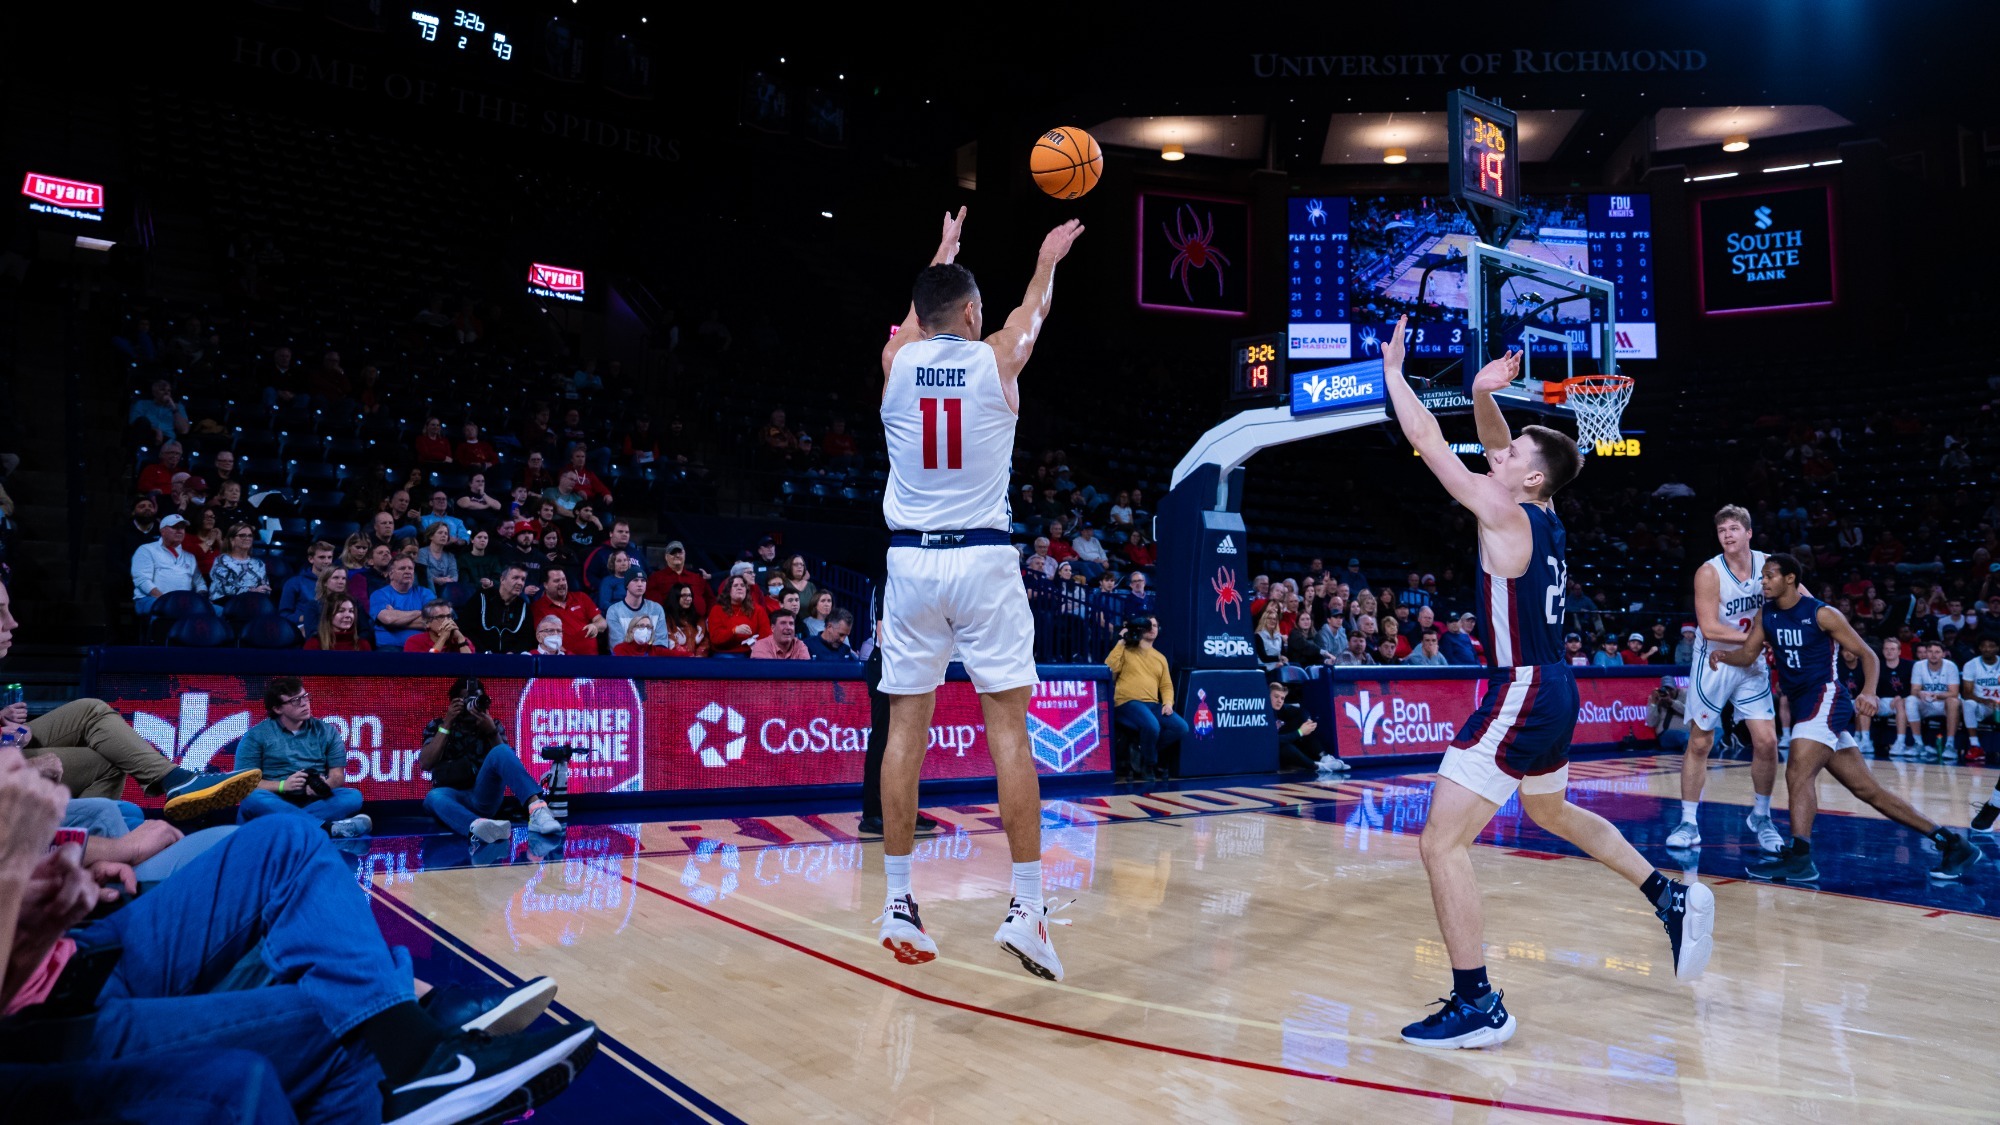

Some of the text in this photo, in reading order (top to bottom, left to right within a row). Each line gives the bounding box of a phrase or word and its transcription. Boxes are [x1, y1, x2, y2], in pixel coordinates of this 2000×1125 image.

[418, 21, 437, 41] 73
[454, 9, 485, 32] 3:26
[458, 36, 467, 49] 2
[492, 41, 512, 60] 43
[1460, 53, 1502, 75] OF
[231, 34, 682, 163] HOME OF THE SPIDERS
[1473, 116, 1506, 152] 3:26
[1480, 152, 1505, 197] 19
[35, 178, 94, 203] bryant
[1610, 196, 1631, 210] FDU
[1727, 230, 1803, 253] SOUTH
[1732, 249, 1800, 274] STATE
[537, 267, 577, 287] bryant
[1747, 269, 1786, 282] BANK
[1404, 328, 1425, 343] 73
[1450, 328, 1462, 343] 3
[916, 367, 966, 387] ROCHE
[1252, 365, 1268, 388] 19
[1332, 375, 1357, 388] Bon
[1324, 383, 1373, 401] Secours
[1423, 391, 1453, 399] YEATMAN
[919, 397, 962, 470] 11
[1725, 594, 1766, 617] SPIDER
[1776, 628, 1803, 647] FDU
[1785, 649, 1801, 668] 21
[1217, 695, 1265, 711] SHERWIN
[1392, 698, 1431, 723] Bon
[531, 708, 630, 733] CORNER
[1382, 718, 1454, 744] Secours
[760, 717, 871, 754] CoStar
[885, 903, 907, 913] DAME
